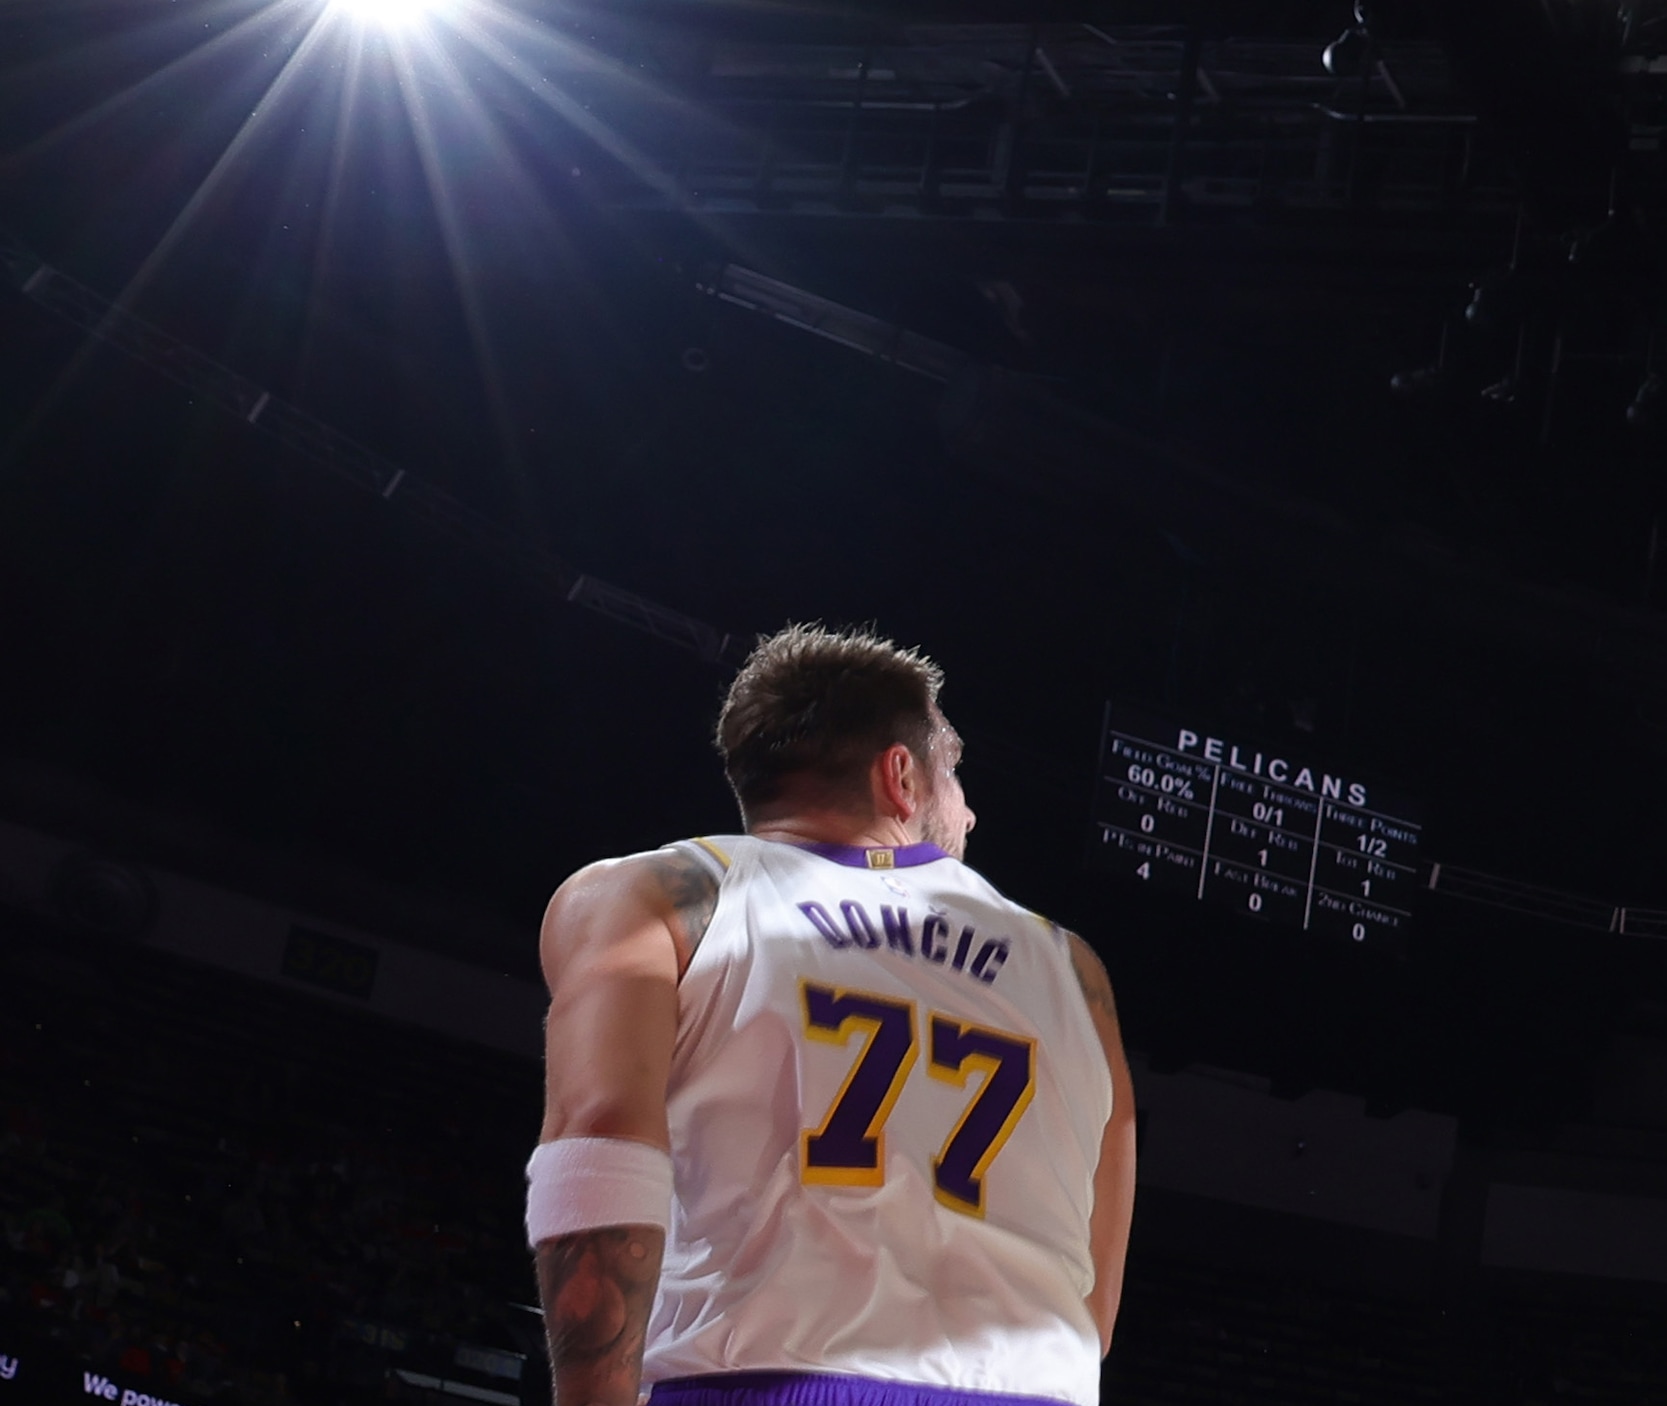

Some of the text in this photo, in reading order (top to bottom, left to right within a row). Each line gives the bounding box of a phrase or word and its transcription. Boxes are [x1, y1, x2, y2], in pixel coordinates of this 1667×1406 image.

[1178, 729, 1367, 807] PELICANS
[1127, 764, 1194, 801] 60.0%
[1140, 814, 1155, 833] 0
[1252, 803, 1284, 827] 0/1
[1357, 834, 1388, 858] 1/2
[1258, 849, 1269, 867] 1
[1136, 862, 1151, 881] 4
[1361, 879, 1372, 897] 1
[1248, 893, 1262, 913] 0
[1352, 923, 1366, 942] 0
[798, 975, 1038, 1219] 77
[83, 1371, 117, 1401] We
